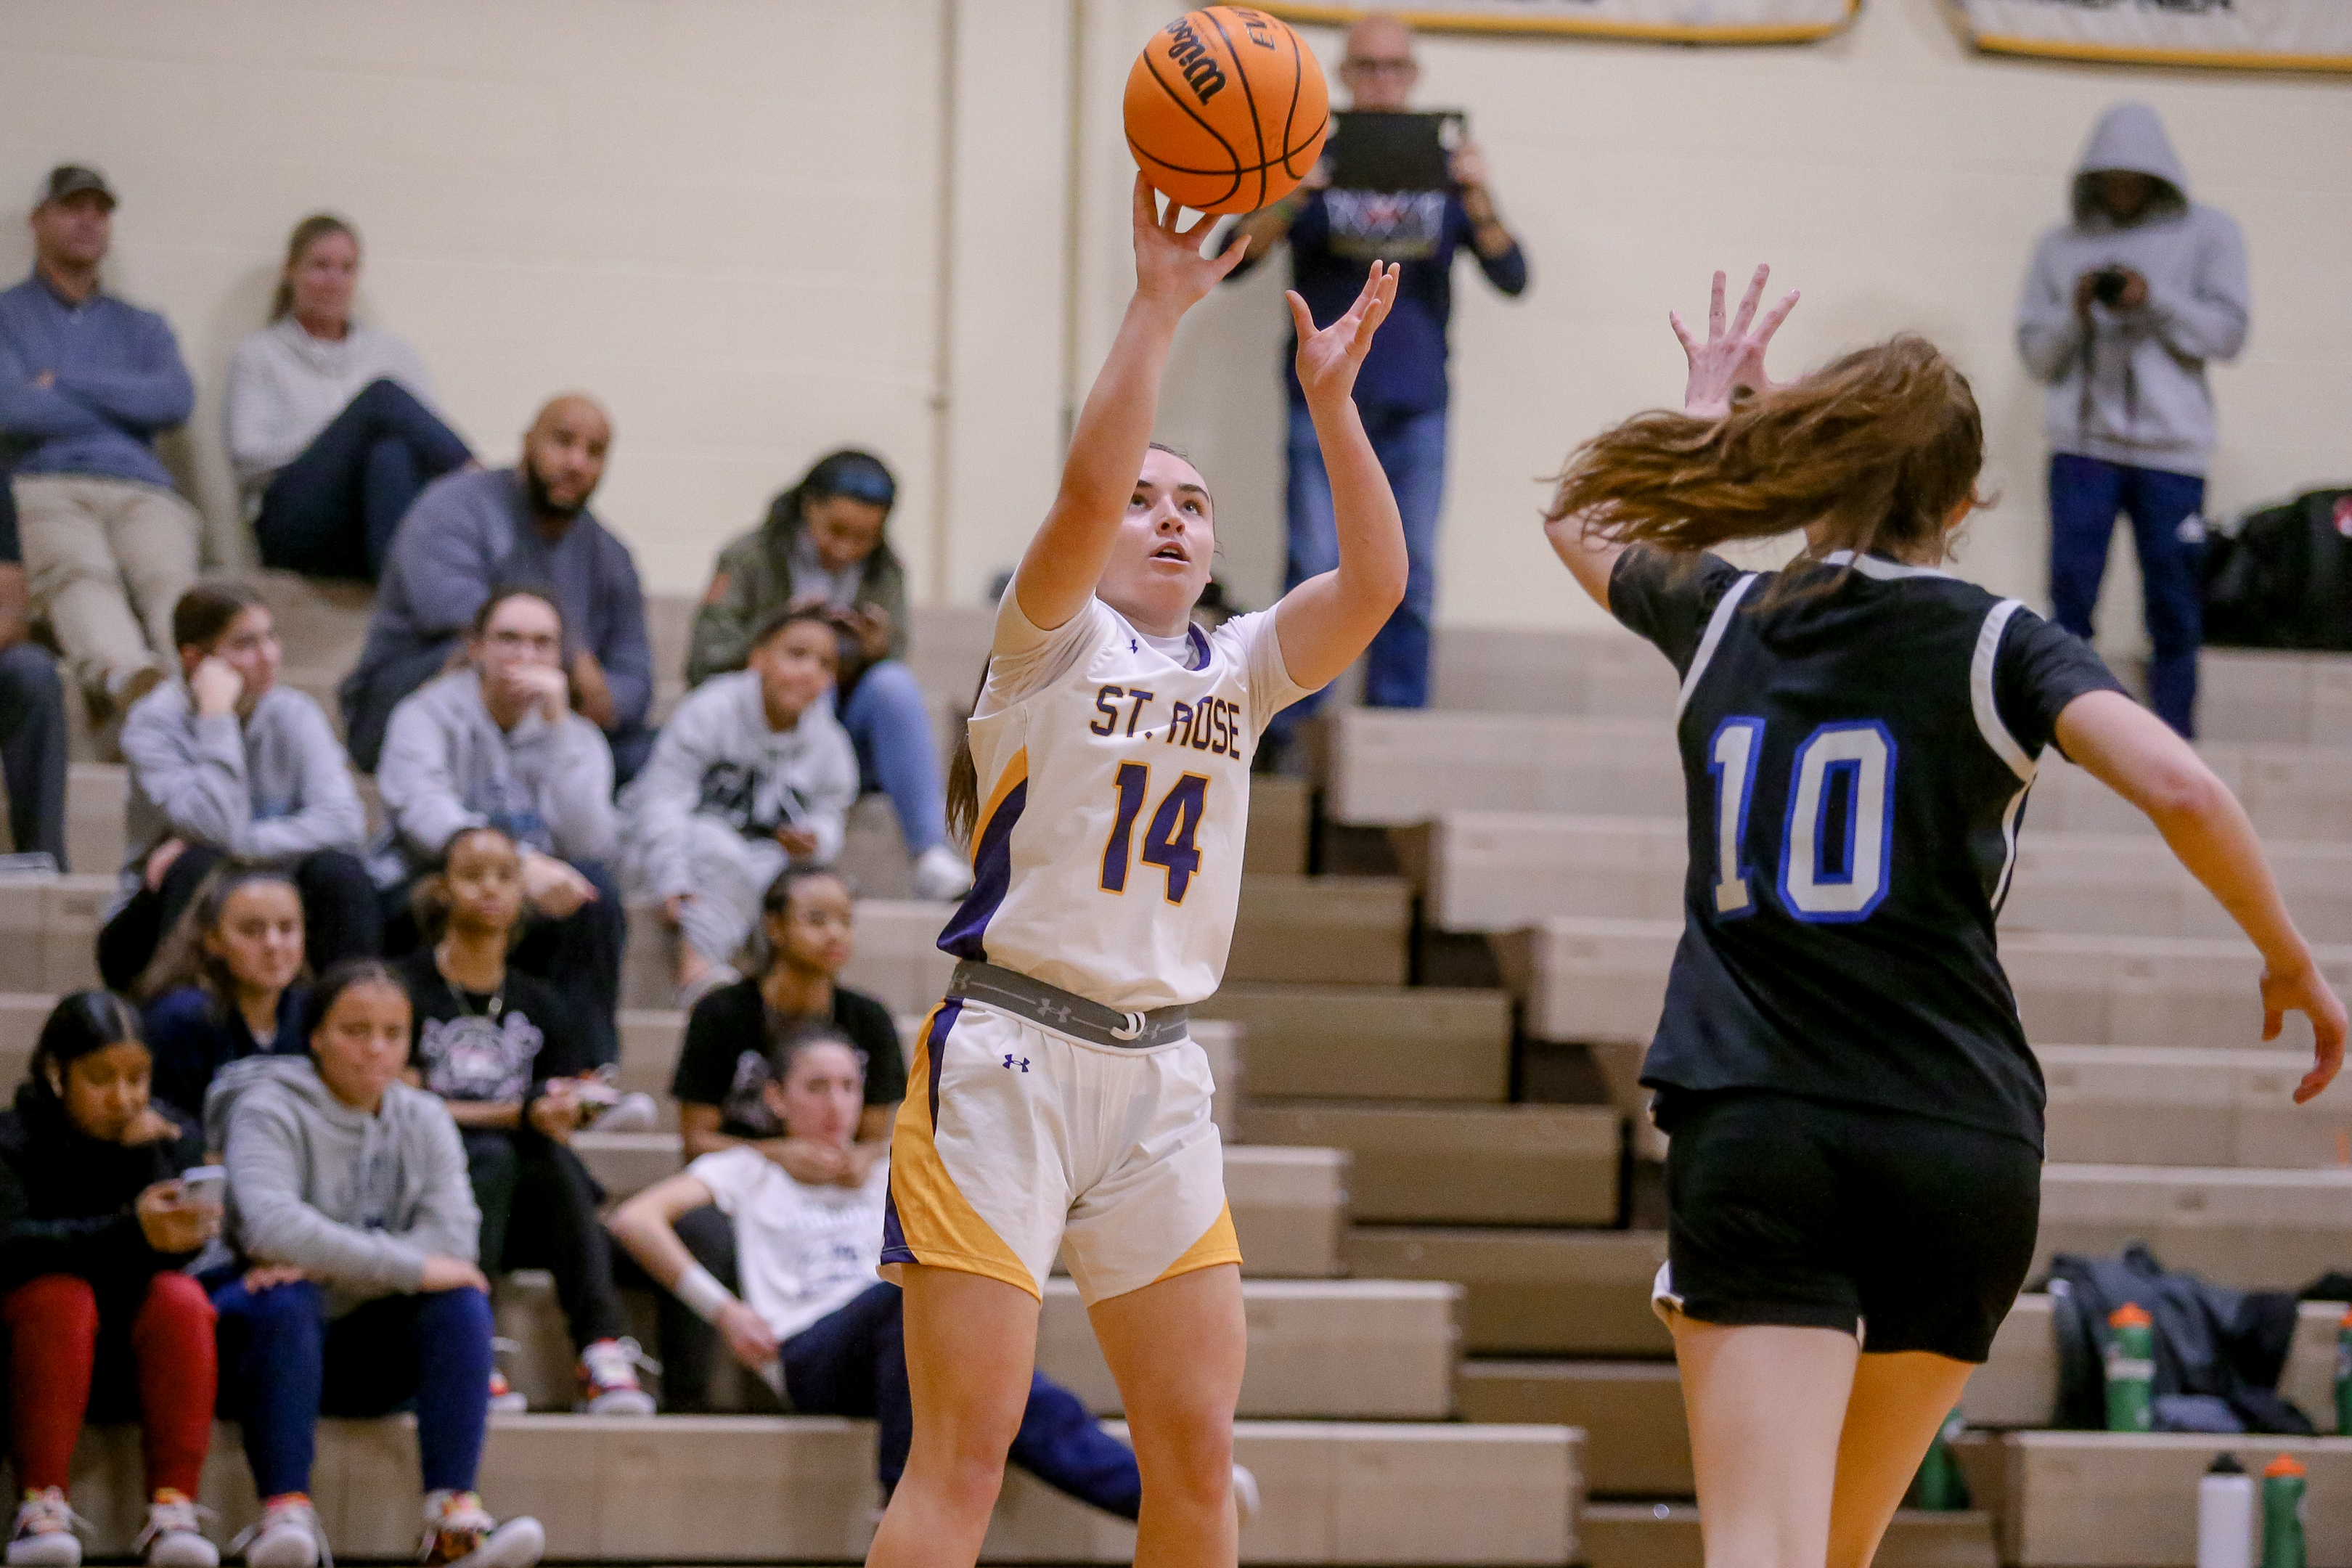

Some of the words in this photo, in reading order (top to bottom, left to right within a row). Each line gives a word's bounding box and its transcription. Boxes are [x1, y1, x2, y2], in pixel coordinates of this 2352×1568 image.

[1164, 17, 1226, 107] Wilso
[1090, 685, 1154, 740] ST.
[1166, 694, 1240, 761] ROSE
[1098, 759, 1212, 907] 14
[1707, 715, 1898, 921] 10
